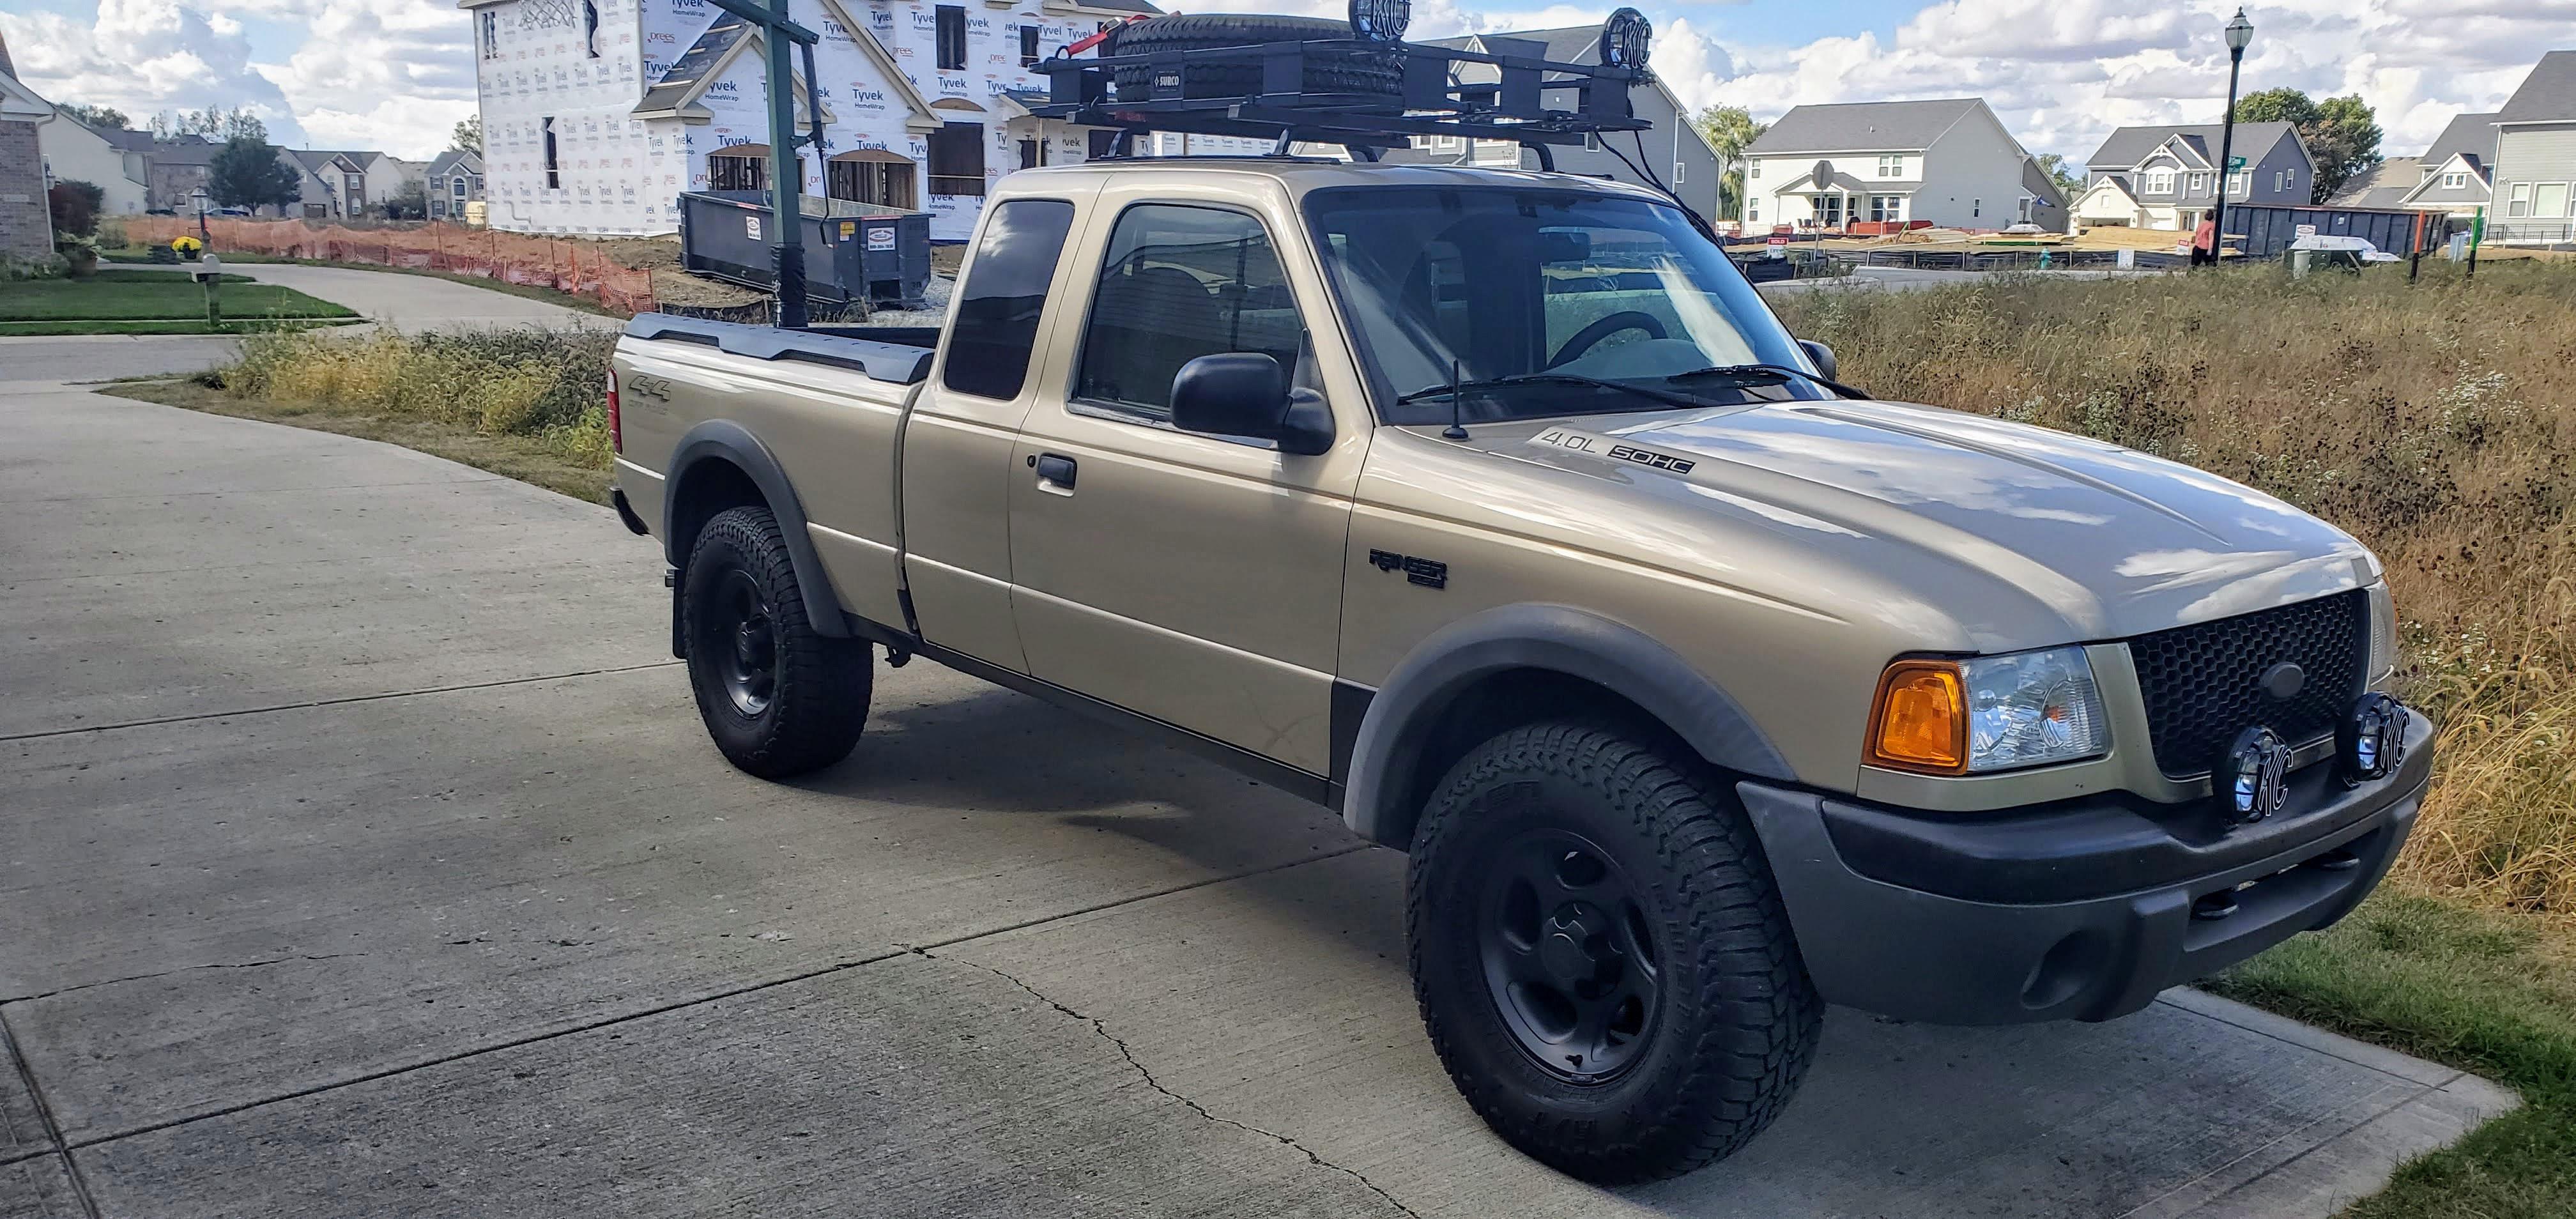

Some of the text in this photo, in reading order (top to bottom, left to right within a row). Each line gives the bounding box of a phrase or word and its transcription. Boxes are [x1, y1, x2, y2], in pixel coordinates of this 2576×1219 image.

[911, 12, 935, 24] Tyve
[966, 18, 990, 29] yvek
[824, 20, 848, 34] Tyve
[1623, 15, 1652, 69] KC
[710, 80, 737, 93] yvek
[938, 77, 967, 89] Tyvek
[1160, 75, 1179, 86] SURCO
[852, 89, 884, 102] Tyvek
[909, 142, 926, 155] Tyv
[1541, 431, 1695, 473] 4.0L SOHC
[2380, 705, 2410, 774] KC
[2258, 744, 2293, 817] KC
